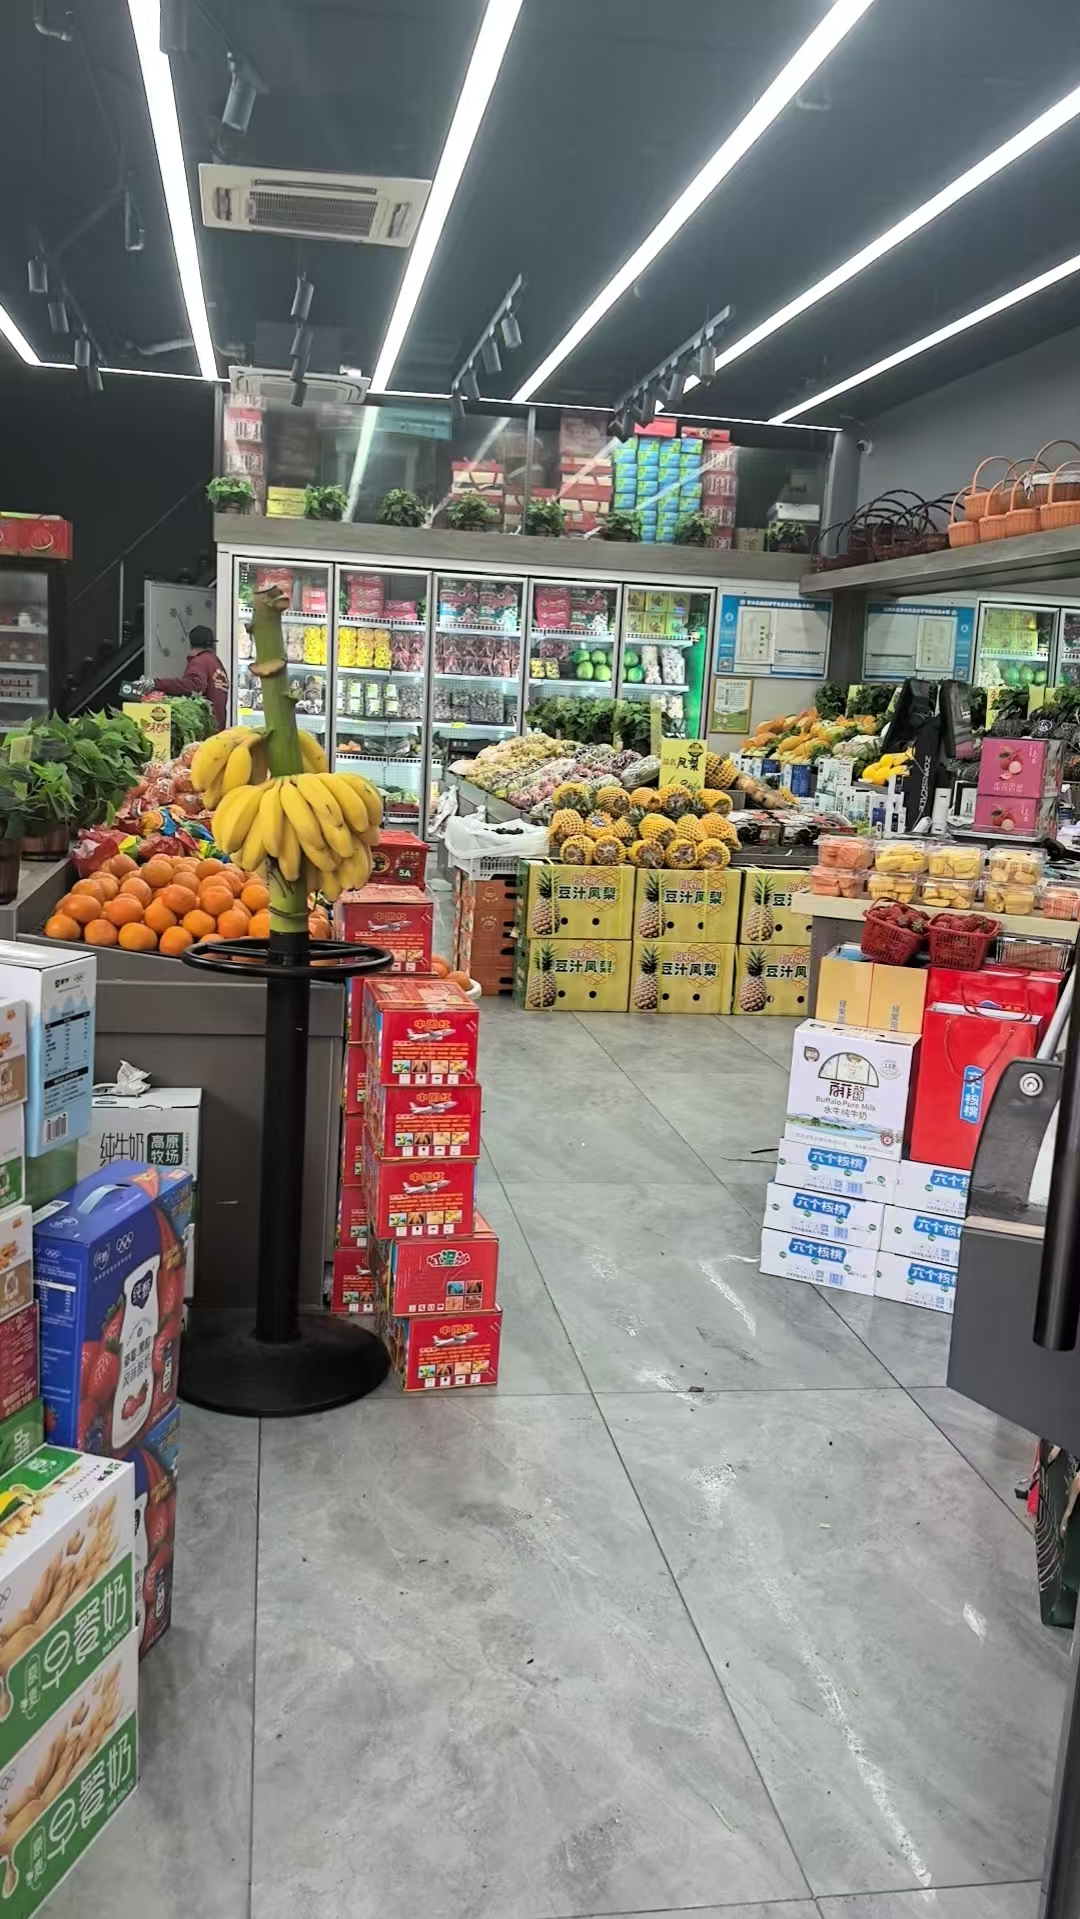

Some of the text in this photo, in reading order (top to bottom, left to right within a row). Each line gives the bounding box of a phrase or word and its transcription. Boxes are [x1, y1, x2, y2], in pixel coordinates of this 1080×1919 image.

[399, 869, 411, 877] 5A
[558, 887, 616, 900] 豆汁凤梨
[664, 890, 722, 904] 豆汁凤梨
[555, 959, 612, 973] 豆汁凤梨
[662, 963, 716, 976] 豆汁凤梨
[414, 1018, 451, 1029] 中国红
[416, 1092, 452, 1103] 中国红
[964, 1071, 982, 1118] 六个核桃
[816, 1095, 877, 1112] Buffalo Pure Milk
[823, 1105, 868, 1120] 水牛纯牛奶
[100, 1132, 144, 1166] 纯牛奶
[151, 1134, 179, 1149] 高原
[151, 1149, 179, 1164] 牧场
[810, 1150, 865, 1169] 六个核桃
[409, 1172, 445, 1182] 中国红
[796, 1195, 848, 1217] 六个核桃
[792, 1240, 844, 1260] 六个核桃
[440, 1323, 474, 1335] 中国红
[42, 1573, 126, 1690] 早餐奶
[47, 1733, 131, 1860] 早餐奶
